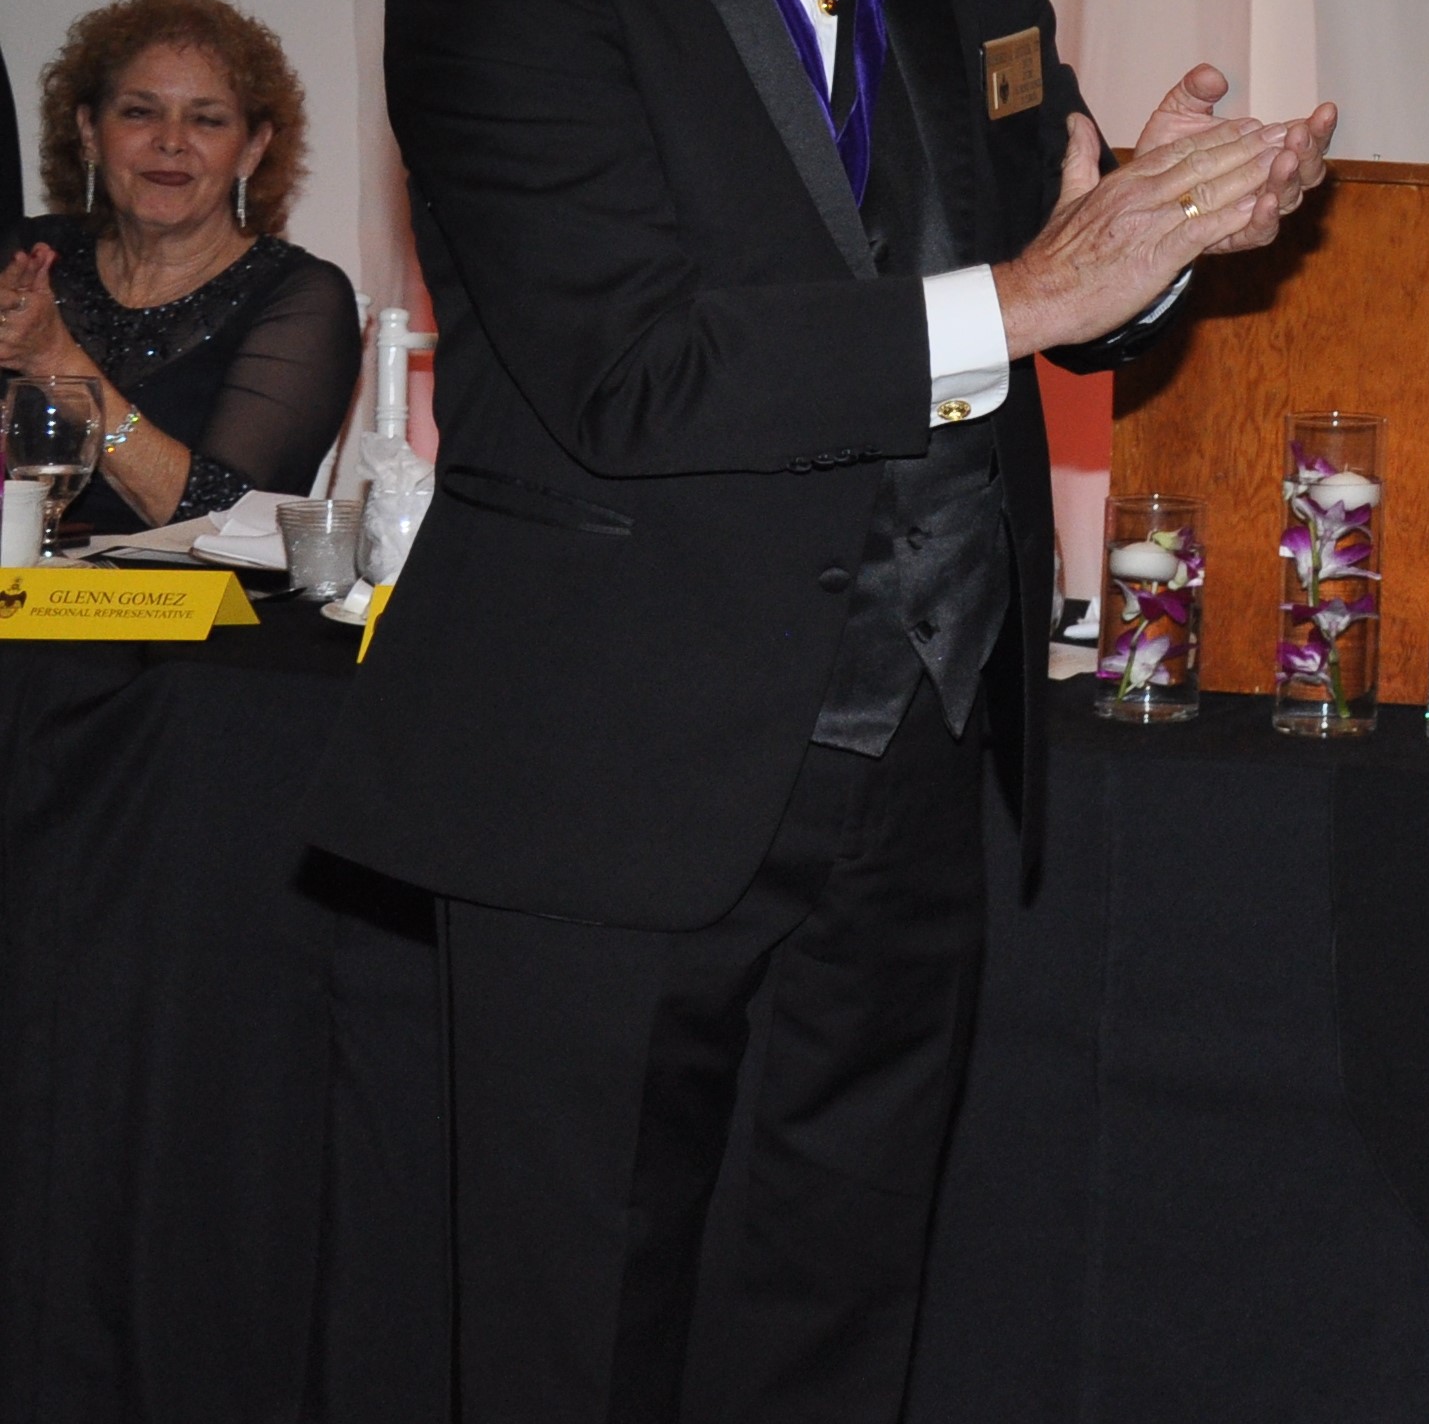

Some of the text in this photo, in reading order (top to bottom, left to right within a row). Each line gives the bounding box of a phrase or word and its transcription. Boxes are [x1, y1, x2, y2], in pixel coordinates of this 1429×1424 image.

[49, 590, 187, 606] GLENN GOMEZ
[30, 607, 195, 619] PERSONAL REPRESENTATIVE
